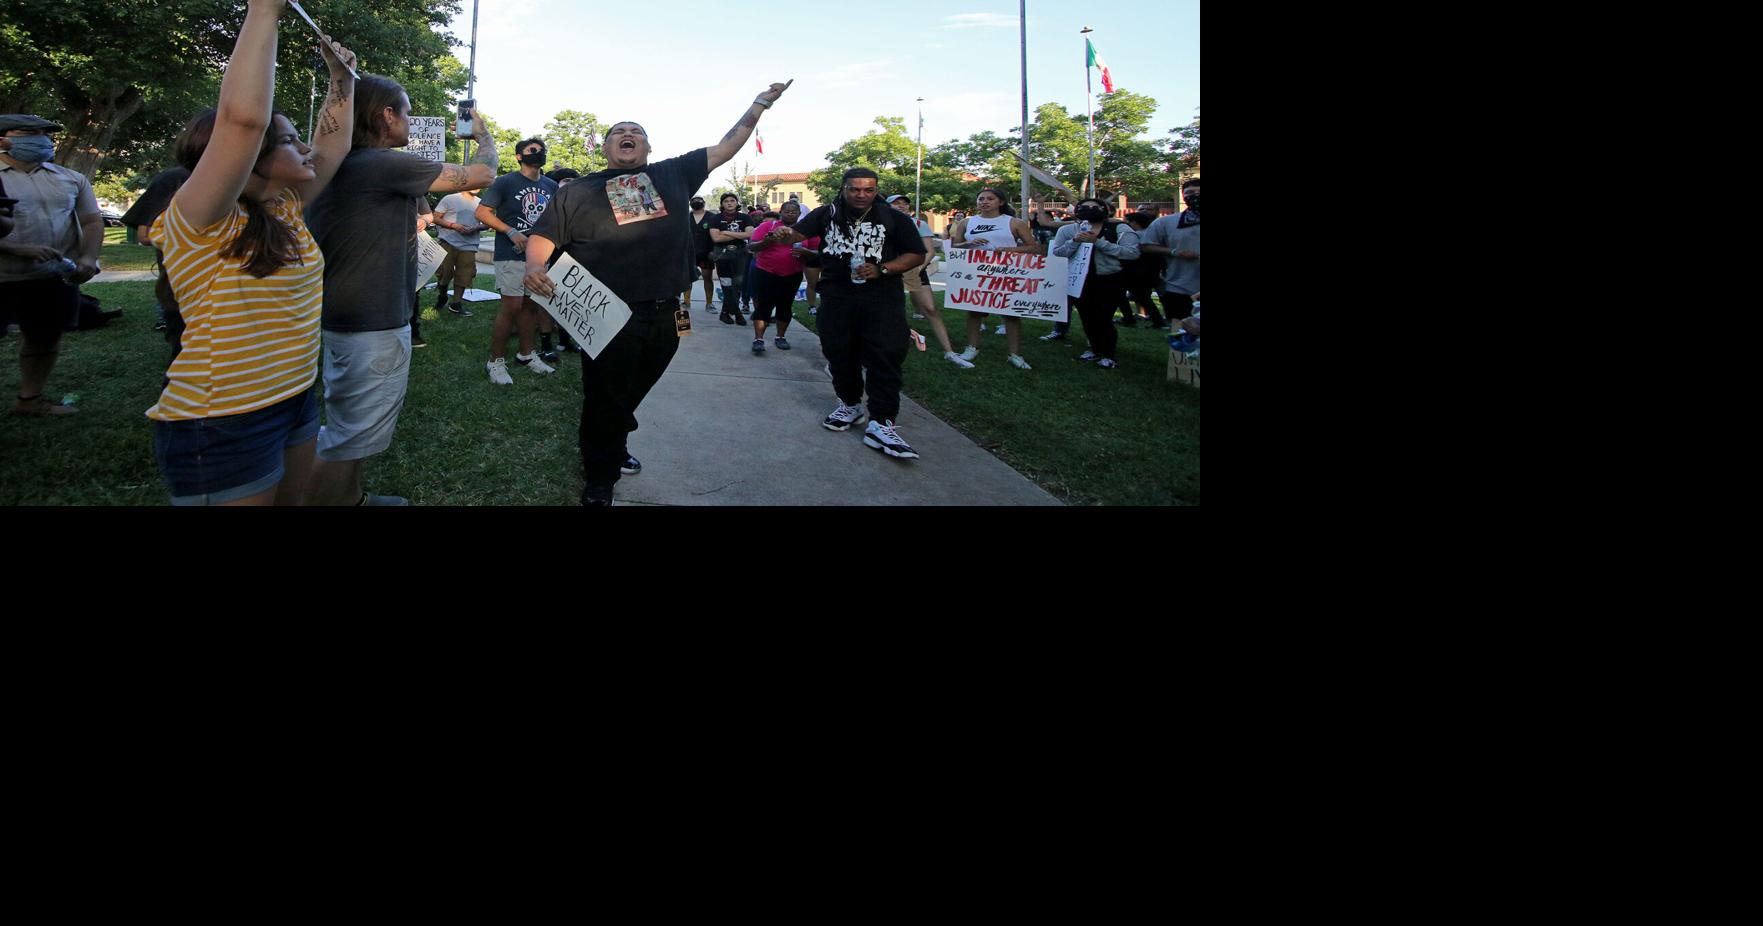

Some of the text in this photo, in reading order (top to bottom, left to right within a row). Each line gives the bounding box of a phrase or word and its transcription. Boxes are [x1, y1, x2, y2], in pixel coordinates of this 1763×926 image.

[423, 117, 445, 127] YEARS
[949, 250, 1046, 268] BLM INJUSTICE
[977, 264, 1028, 276] anywhere
[562, 264, 611, 319] BLACK
[977, 275, 1045, 295] THREAT
[951, 288, 1061, 314] JUSTICE everywhere
[549, 294, 596, 346] MATTER
